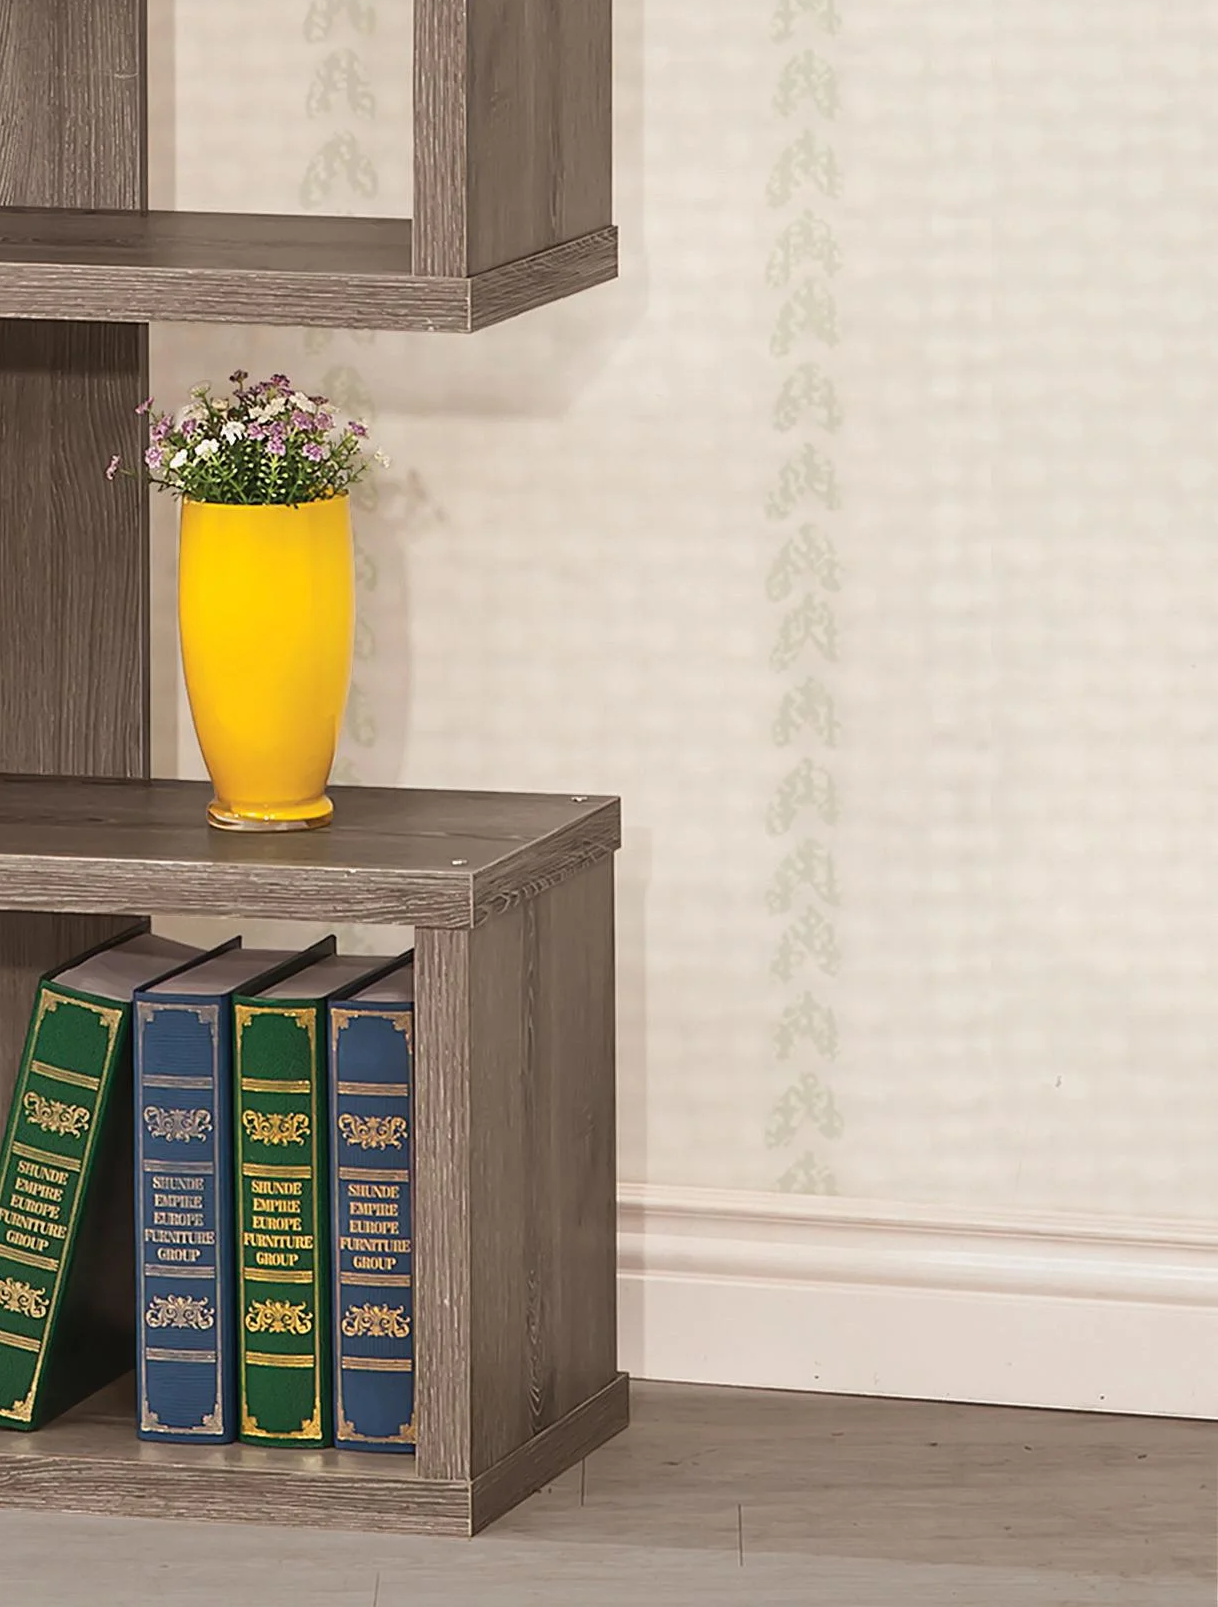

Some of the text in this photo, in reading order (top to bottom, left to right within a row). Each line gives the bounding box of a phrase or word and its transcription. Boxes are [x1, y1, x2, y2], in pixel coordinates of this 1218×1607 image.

[17, 1160, 68, 1185] SHUNDE
[15, 1177, 63, 1202] EMPIRE
[152, 1176, 204, 1190] SHUNDE
[251, 1179, 302, 1195] SHUNDE
[348, 1184, 400, 1199] SHUNDE
[10, 1194, 60, 1219] EUROPE
[154, 1193, 202, 1208] EMPIRE
[253, 1197, 301, 1213] EMPIRE
[349, 1202, 398, 1216] EMPIRE
[154, 1212, 204, 1226] EUROPE
[253, 1216, 301, 1231] EUROPE
[349, 1220, 399, 1234] EUROPE
[6, 1230, 49, 1251] GROUP
[145, 1228, 215, 1244] FURNITURE
[244, 1233, 313, 1249] FURNITURE
[340, 1237, 411, 1252] FURNITURE
[157, 1247, 201, 1262] GROUP
[256, 1252, 299, 1266] GROUP
[353, 1256, 396, 1270] GROUP
